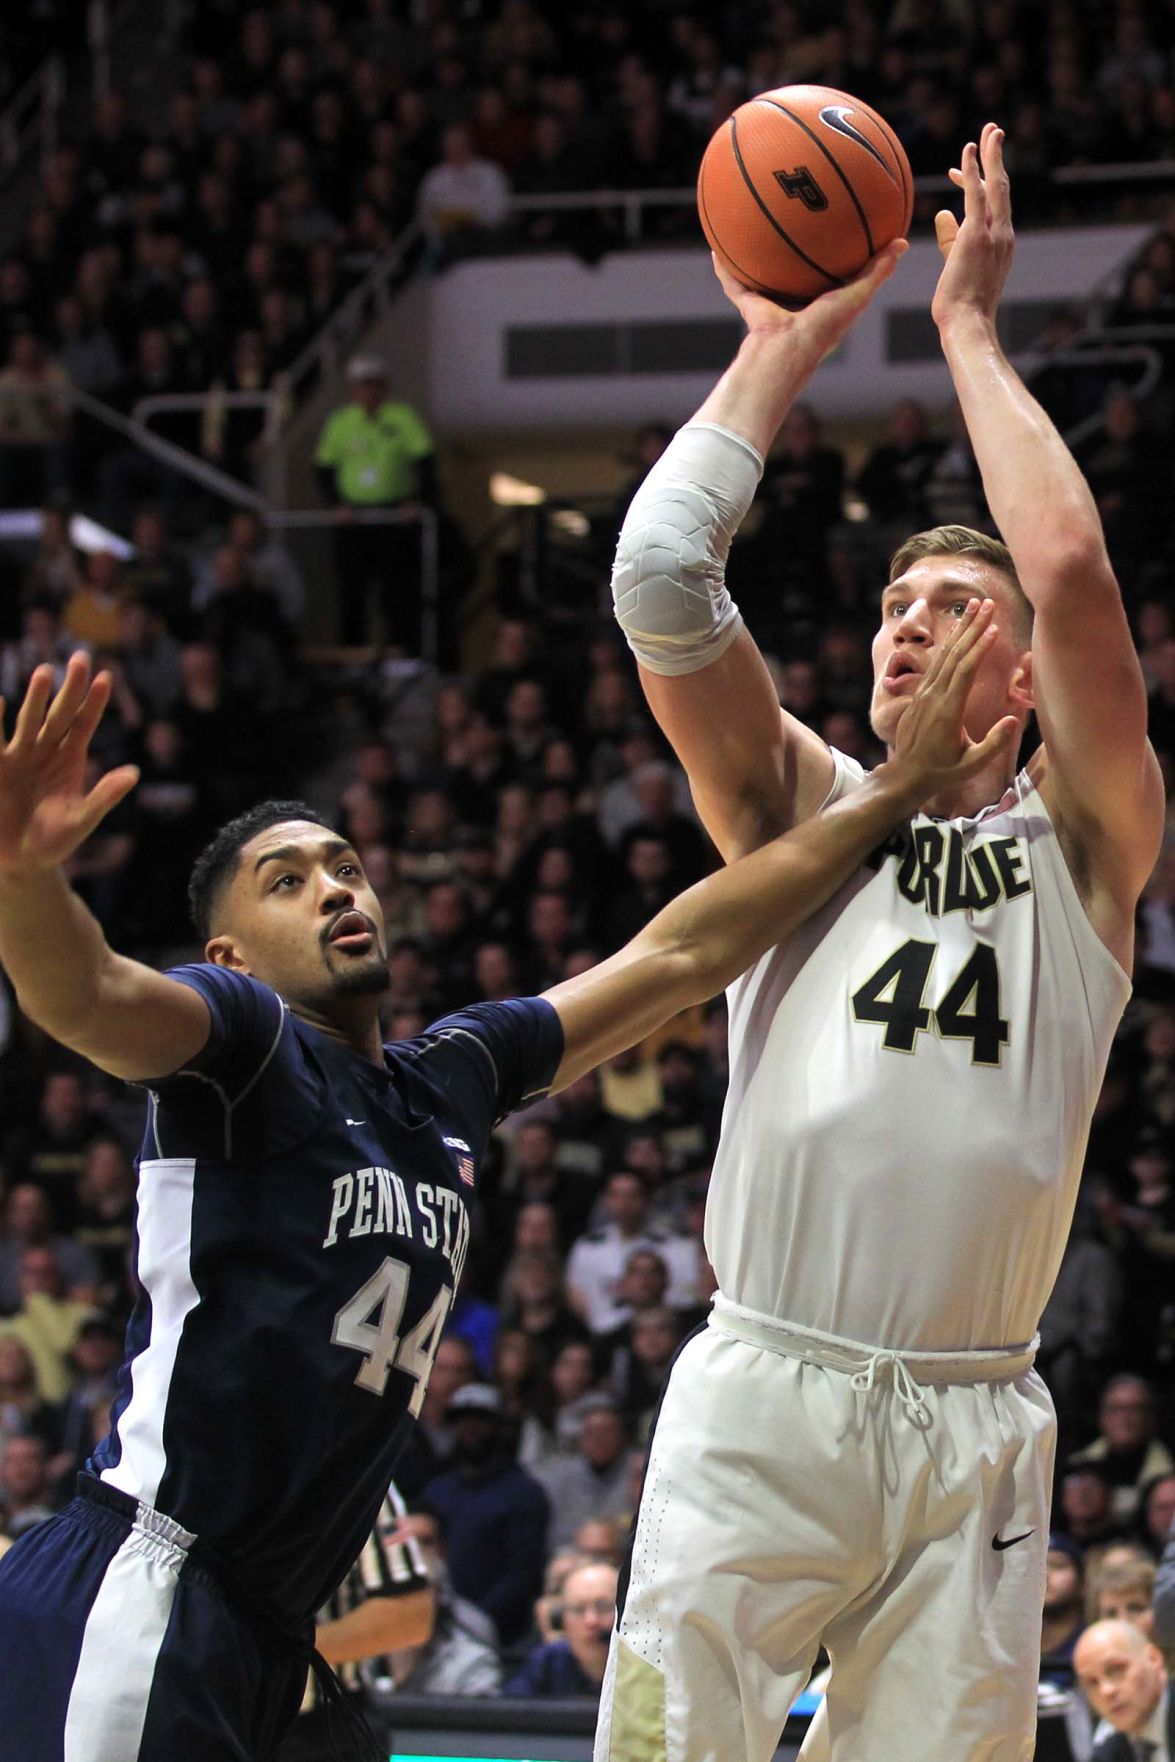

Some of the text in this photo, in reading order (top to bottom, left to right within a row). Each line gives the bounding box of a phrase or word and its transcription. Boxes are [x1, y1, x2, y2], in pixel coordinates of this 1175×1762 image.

[772, 166, 829, 213] P
[850, 937, 1011, 1068] 44
[322, 1166, 471, 1311] PENN STA
[329, 1255, 453, 1421] 44
